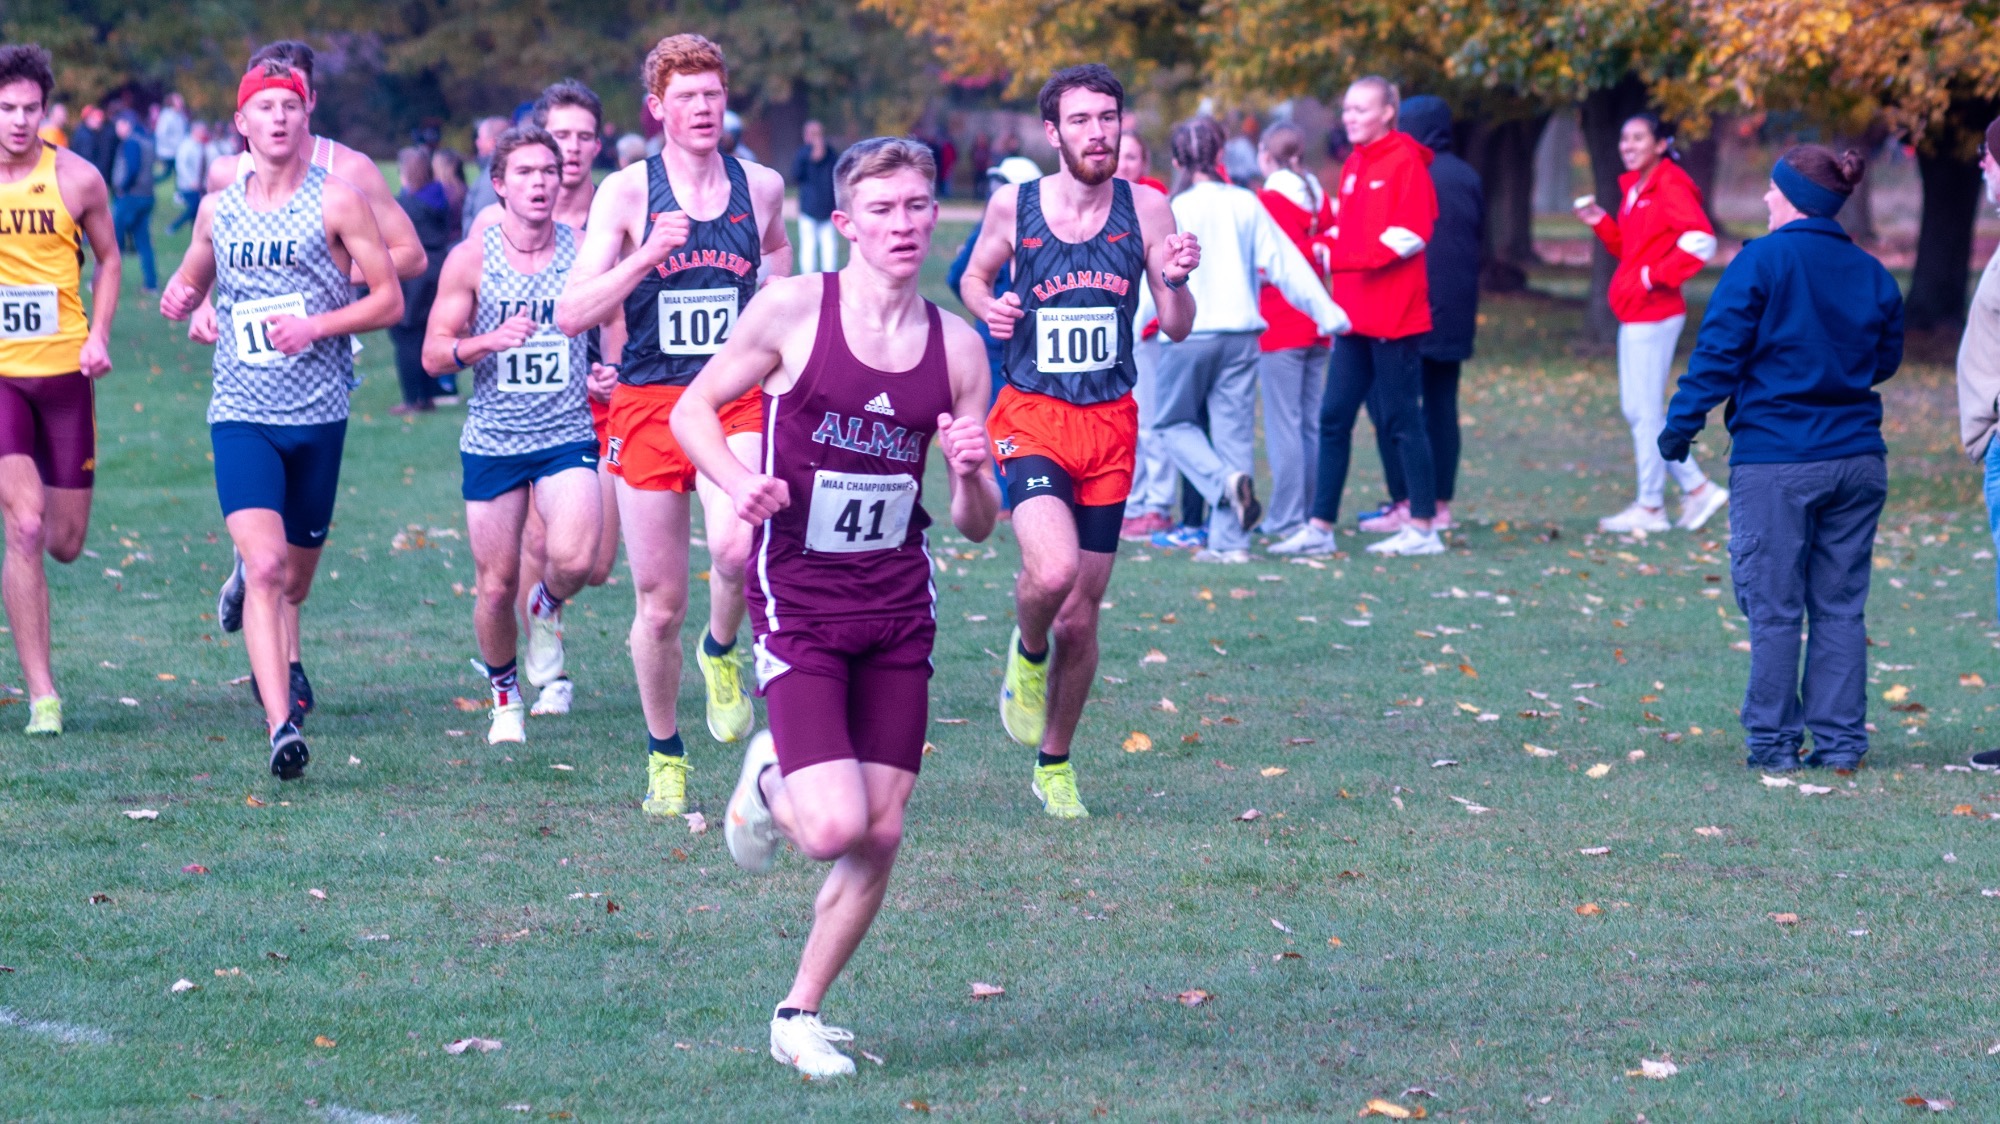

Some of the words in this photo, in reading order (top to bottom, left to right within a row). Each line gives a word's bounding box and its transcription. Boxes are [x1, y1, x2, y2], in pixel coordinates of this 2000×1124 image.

[229, 240, 298, 268] TRINE
[655, 249, 752, 279] KALAMAZOO
[682, 292, 737, 304] CHAMPIONSHIPS
[1032, 270, 1130, 302] KALAMAZOO
[2, 301, 42, 333] 56
[250, 299, 302, 315] CHAMPIONSHIPS
[1060, 312, 1116, 322] CHAMPIONSHIPS
[668, 307, 730, 347] 102
[1047, 326, 1111, 365] 100
[505, 352, 564, 386] 152
[811, 411, 926, 464] ALMA
[820, 478, 845, 491] MIAA
[845, 480, 915, 493] CHAMPIONSHIPS
[833, 498, 887, 542] 41
